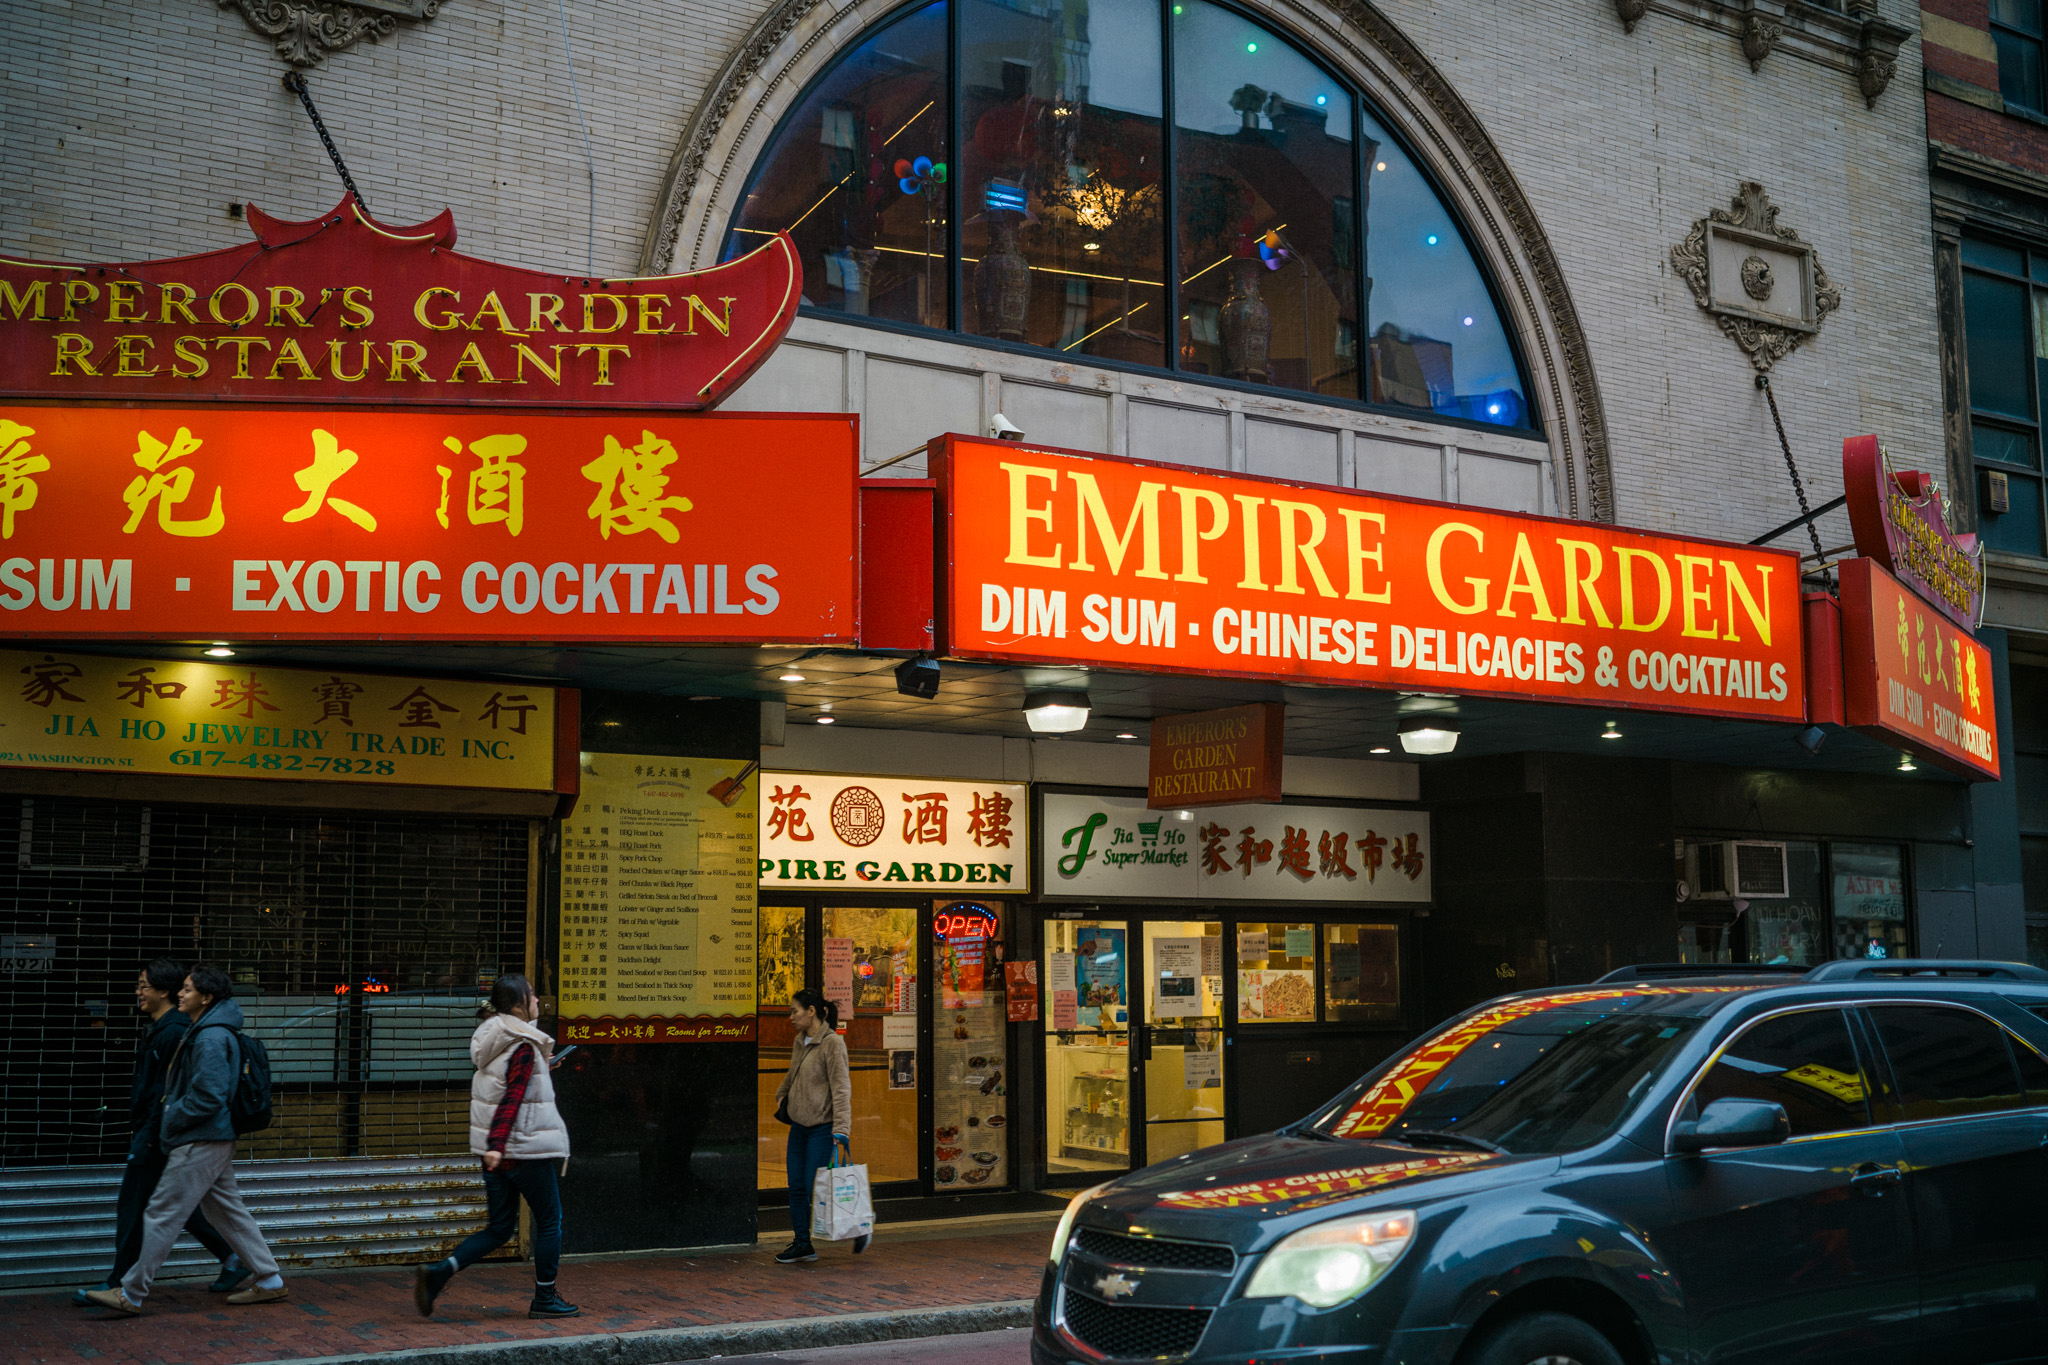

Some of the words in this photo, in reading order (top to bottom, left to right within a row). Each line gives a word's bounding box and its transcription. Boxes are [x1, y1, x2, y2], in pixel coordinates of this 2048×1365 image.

[0, 280, 375, 329] MPEROR'S
[413, 286, 738, 338] GARDEN
[51, 332, 632, 388] RESTAURANT
[999, 461, 1393, 605] EMPIRE
[1425, 520, 1775, 647] GARDEN
[0, 557, 132, 612] SUM
[232, 558, 442, 614] EXOTIC
[461, 561, 780, 616] COCKTAILS
[980, 583, 1067, 640] DIM
[1080, 592, 1177, 649] SUM
[1212, 606, 1378, 667] CHINESE
[1389, 624, 1585, 685] DELICACIES
[1595, 652, 1620, 689] &
[1627, 653, 1788, 703] COCKTAILS
[20, 655, 538, 735] 家和珠寶金行
[1165, 716, 1247, 747] EMPEROR'S
[1889, 677, 1905, 719] DIM
[1906, 687, 1924, 729] SUM
[1933, 702, 1958, 747] EXOTIC
[1959, 716, 1992, 763] COCKTAILS
[45, 714, 99, 738] JIA
[120, 719, 166, 742] HO
[182, 722, 329, 752] JEWELRY
[345, 731, 446, 758] TRADE
[461, 738, 515, 762] INC.
[27, 753, 116, 765] WASHINGTON
[169, 748, 396, 776] 617-482-7828
[1173, 743, 1237, 771] GARDEN
[1153, 767, 1256, 798] RESTAURANT
[620, 807, 643, 816] Peking
[649, 830, 664, 838] Duck
[1111, 827, 1134, 846] Jia
[1163, 828, 1186, 846] Ho
[648, 856, 663, 864] Chop
[1199, 821, 1425, 883] 家和超級市場
[855, 860, 1014, 884] GARDEN
[934, 914, 998, 938] OPEN
[666, 1026, 696, 1037] Rooms
[697, 1027, 711, 1039] for
[714, 1025, 750, 1038] Party!!
